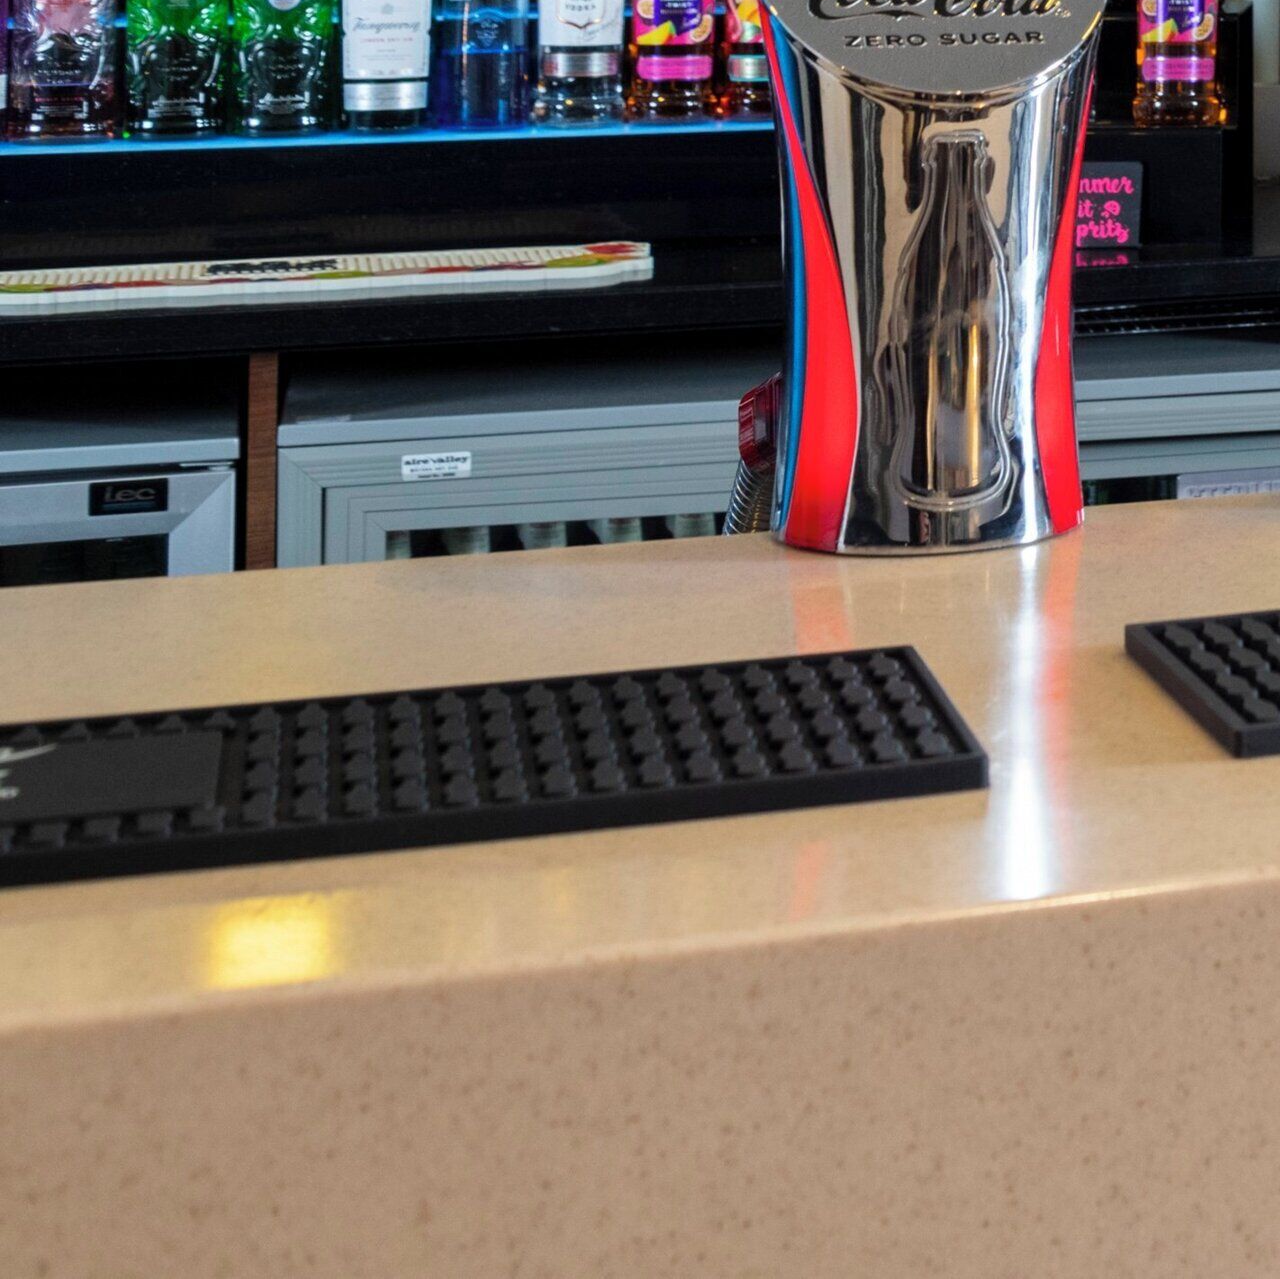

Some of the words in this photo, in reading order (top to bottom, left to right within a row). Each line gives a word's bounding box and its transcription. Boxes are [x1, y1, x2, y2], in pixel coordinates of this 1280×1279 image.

[844, 33, 927, 48] ZERO
[940, 31, 1045, 46] SUGAR
[1080, 176, 1135, 193] mmer
[1076, 219, 1129, 247] pritz
